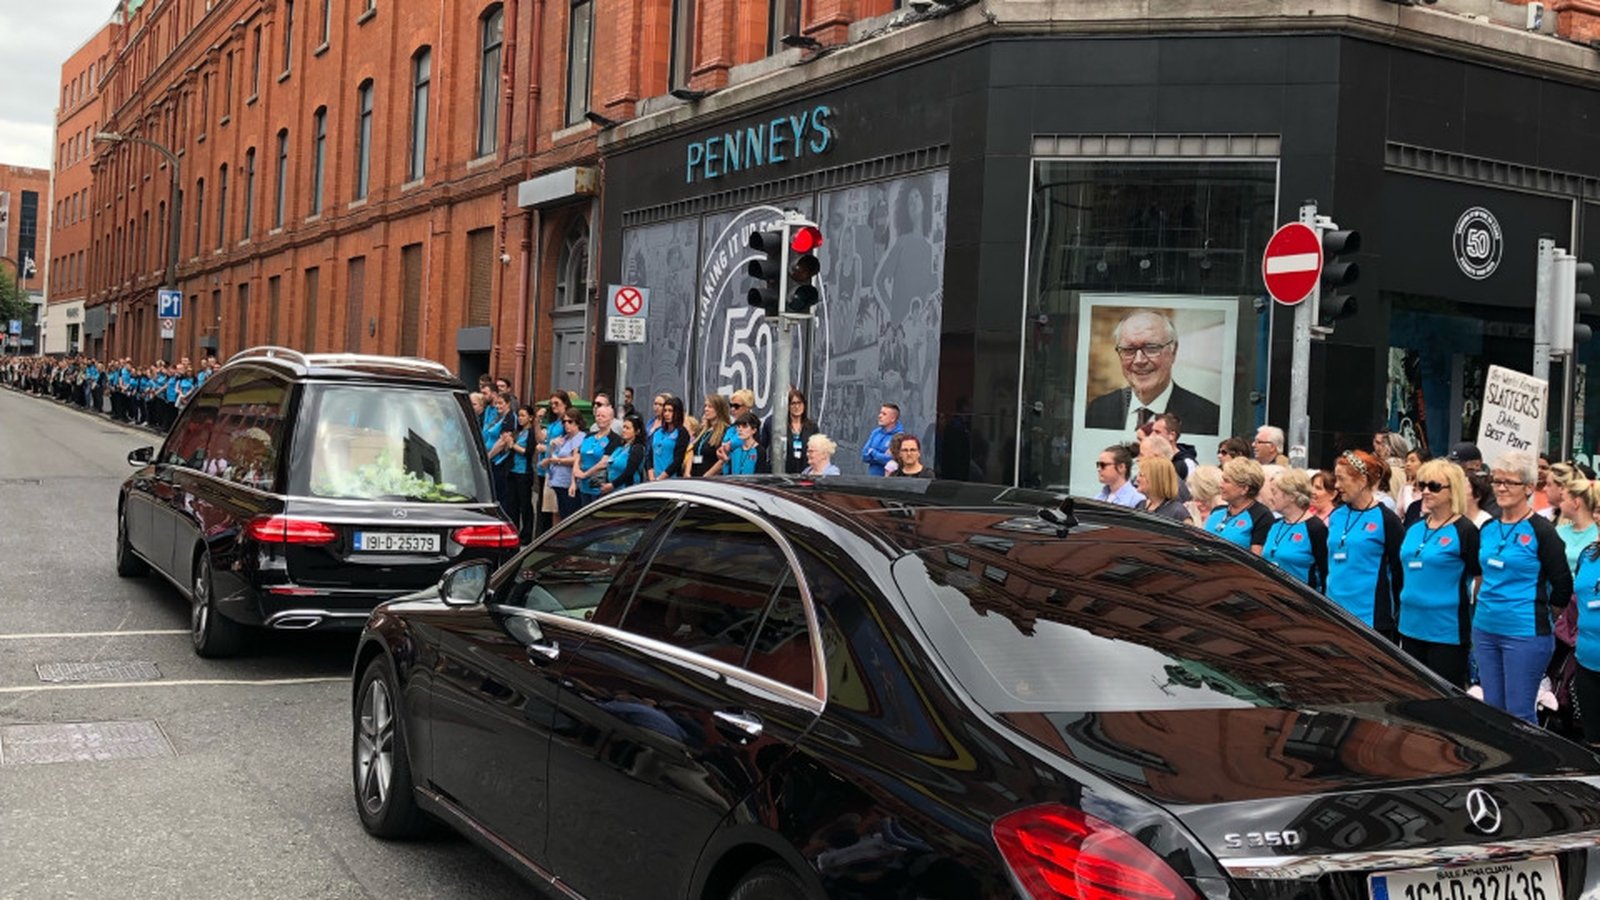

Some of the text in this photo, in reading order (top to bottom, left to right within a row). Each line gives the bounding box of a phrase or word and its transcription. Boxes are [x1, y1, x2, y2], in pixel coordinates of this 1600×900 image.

[686, 105, 831, 184] PENNEYS
[728, 233, 739, 258] IT
[1466, 228, 1490, 259] 50
[161, 294, 172, 315] P
[1485, 424, 1532, 451] BEST PINT
[366, 536, 434, 551] 191-D-25379
[1224, 830, 1301, 849] S 350
